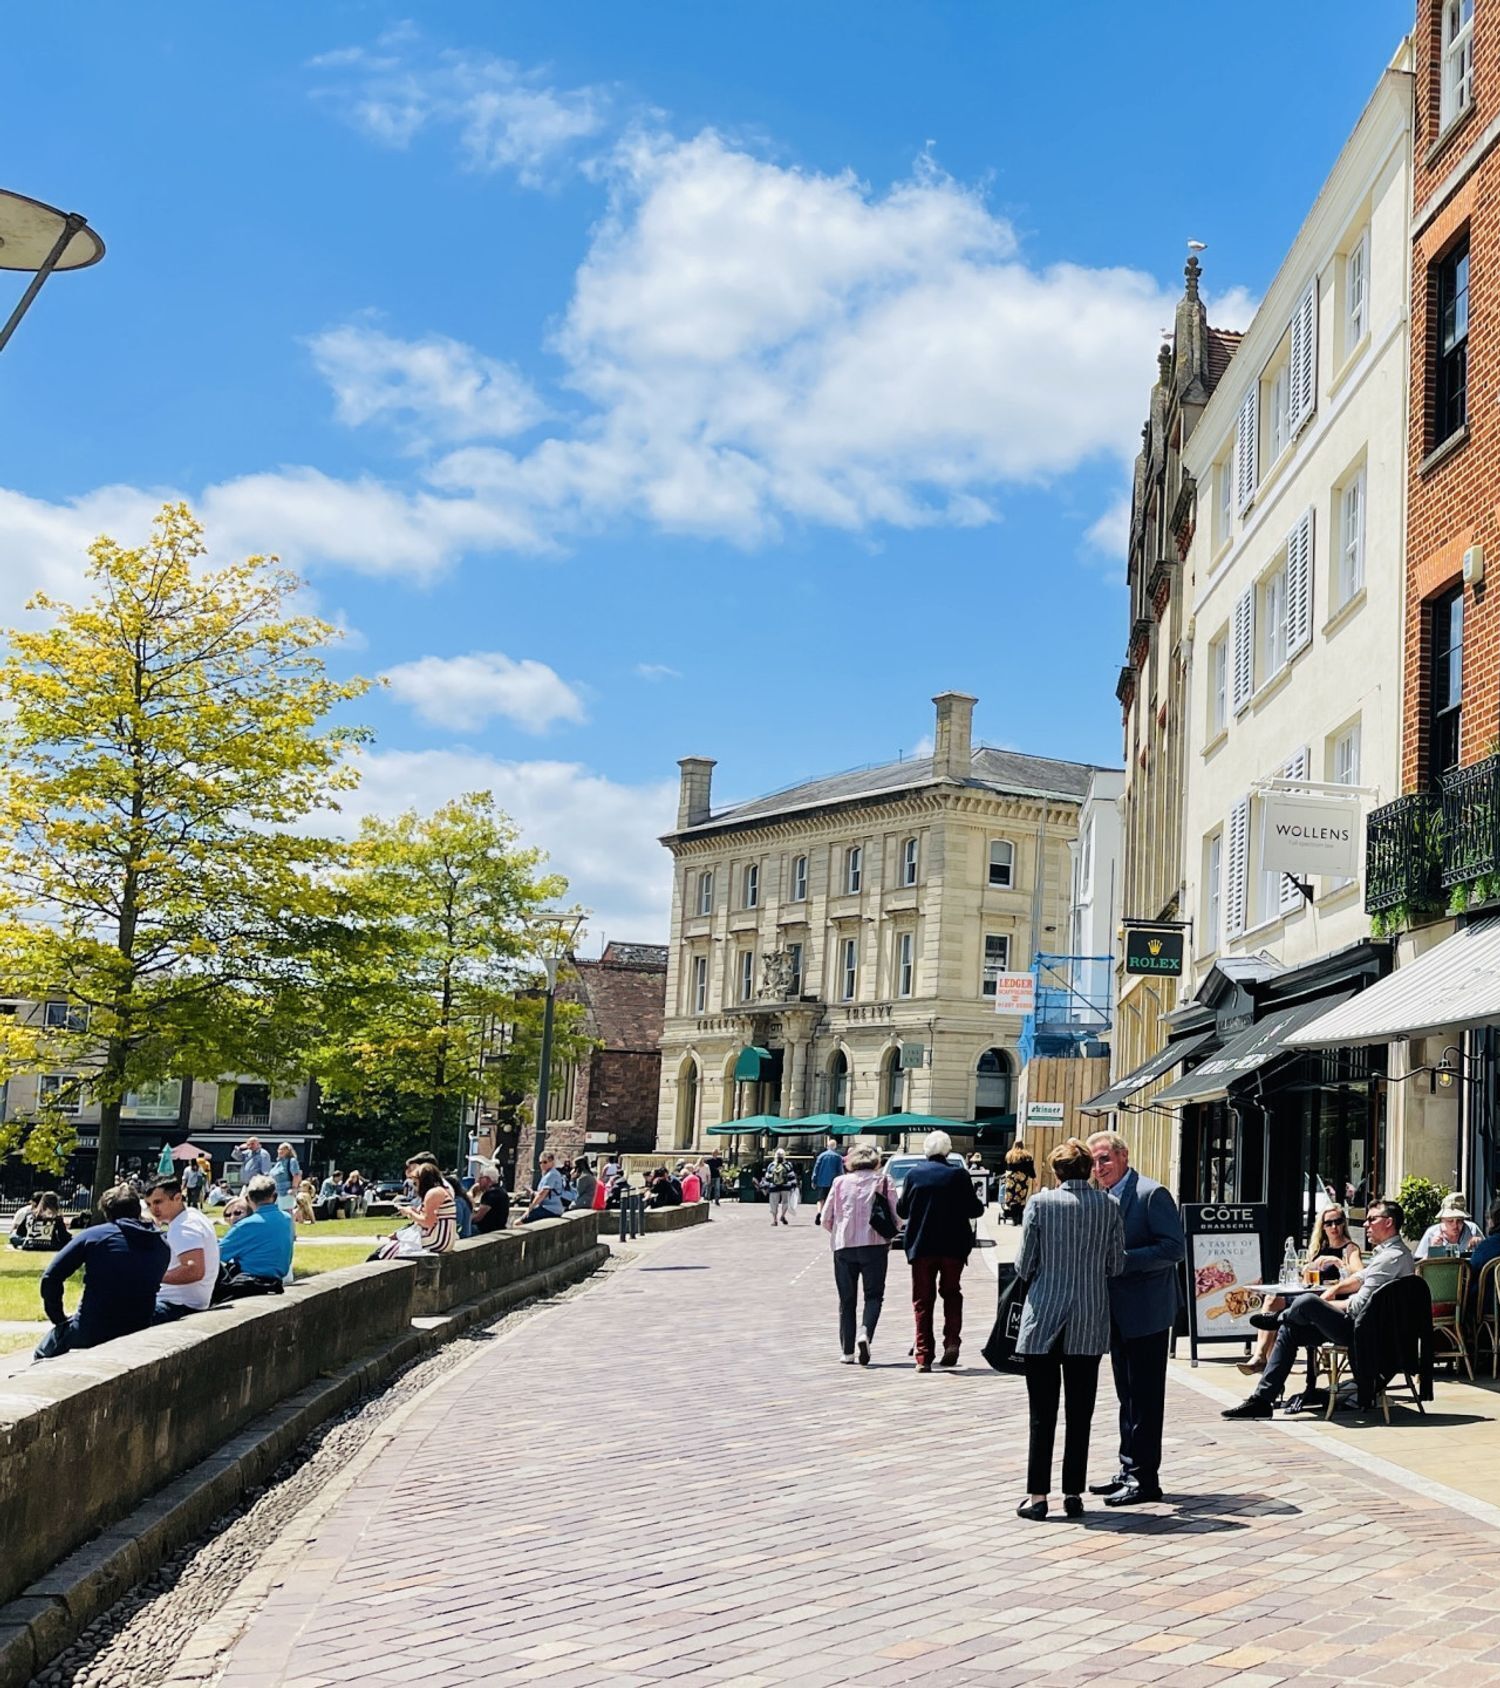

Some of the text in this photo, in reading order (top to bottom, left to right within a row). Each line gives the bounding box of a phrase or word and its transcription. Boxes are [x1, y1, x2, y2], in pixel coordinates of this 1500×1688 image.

[1276, 824, 1349, 841] WOLLENS
[1129, 956, 1180, 970] ROLEX
[999, 978, 1033, 988] LEDGER
[1200, 1206, 1254, 1221] CÔTE
